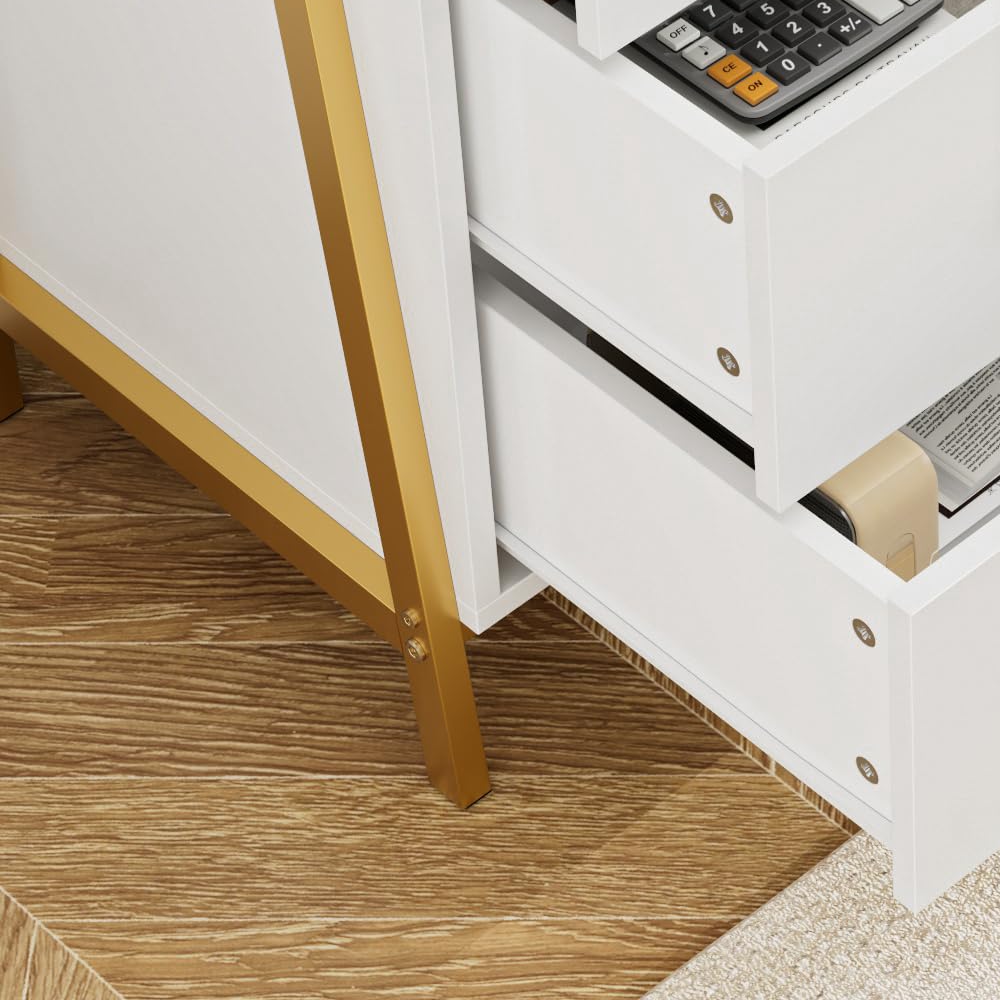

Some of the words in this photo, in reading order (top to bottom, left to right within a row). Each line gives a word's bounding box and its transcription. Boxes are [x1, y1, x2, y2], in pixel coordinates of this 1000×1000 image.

[702, 4, 717, 19] 7
[731, 22, 744, 36] 4
[761, 3, 775, 17] 5
[669, 24, 689, 40] OFF
[756, 40, 769, 54] 1
[786, 20, 802, 34] 2
[816, 1, 831, 15] 3
[722, 61, 737, 74] CE
[781, 58, 796, 73] 0
[747, 79, 764, 93] ON
